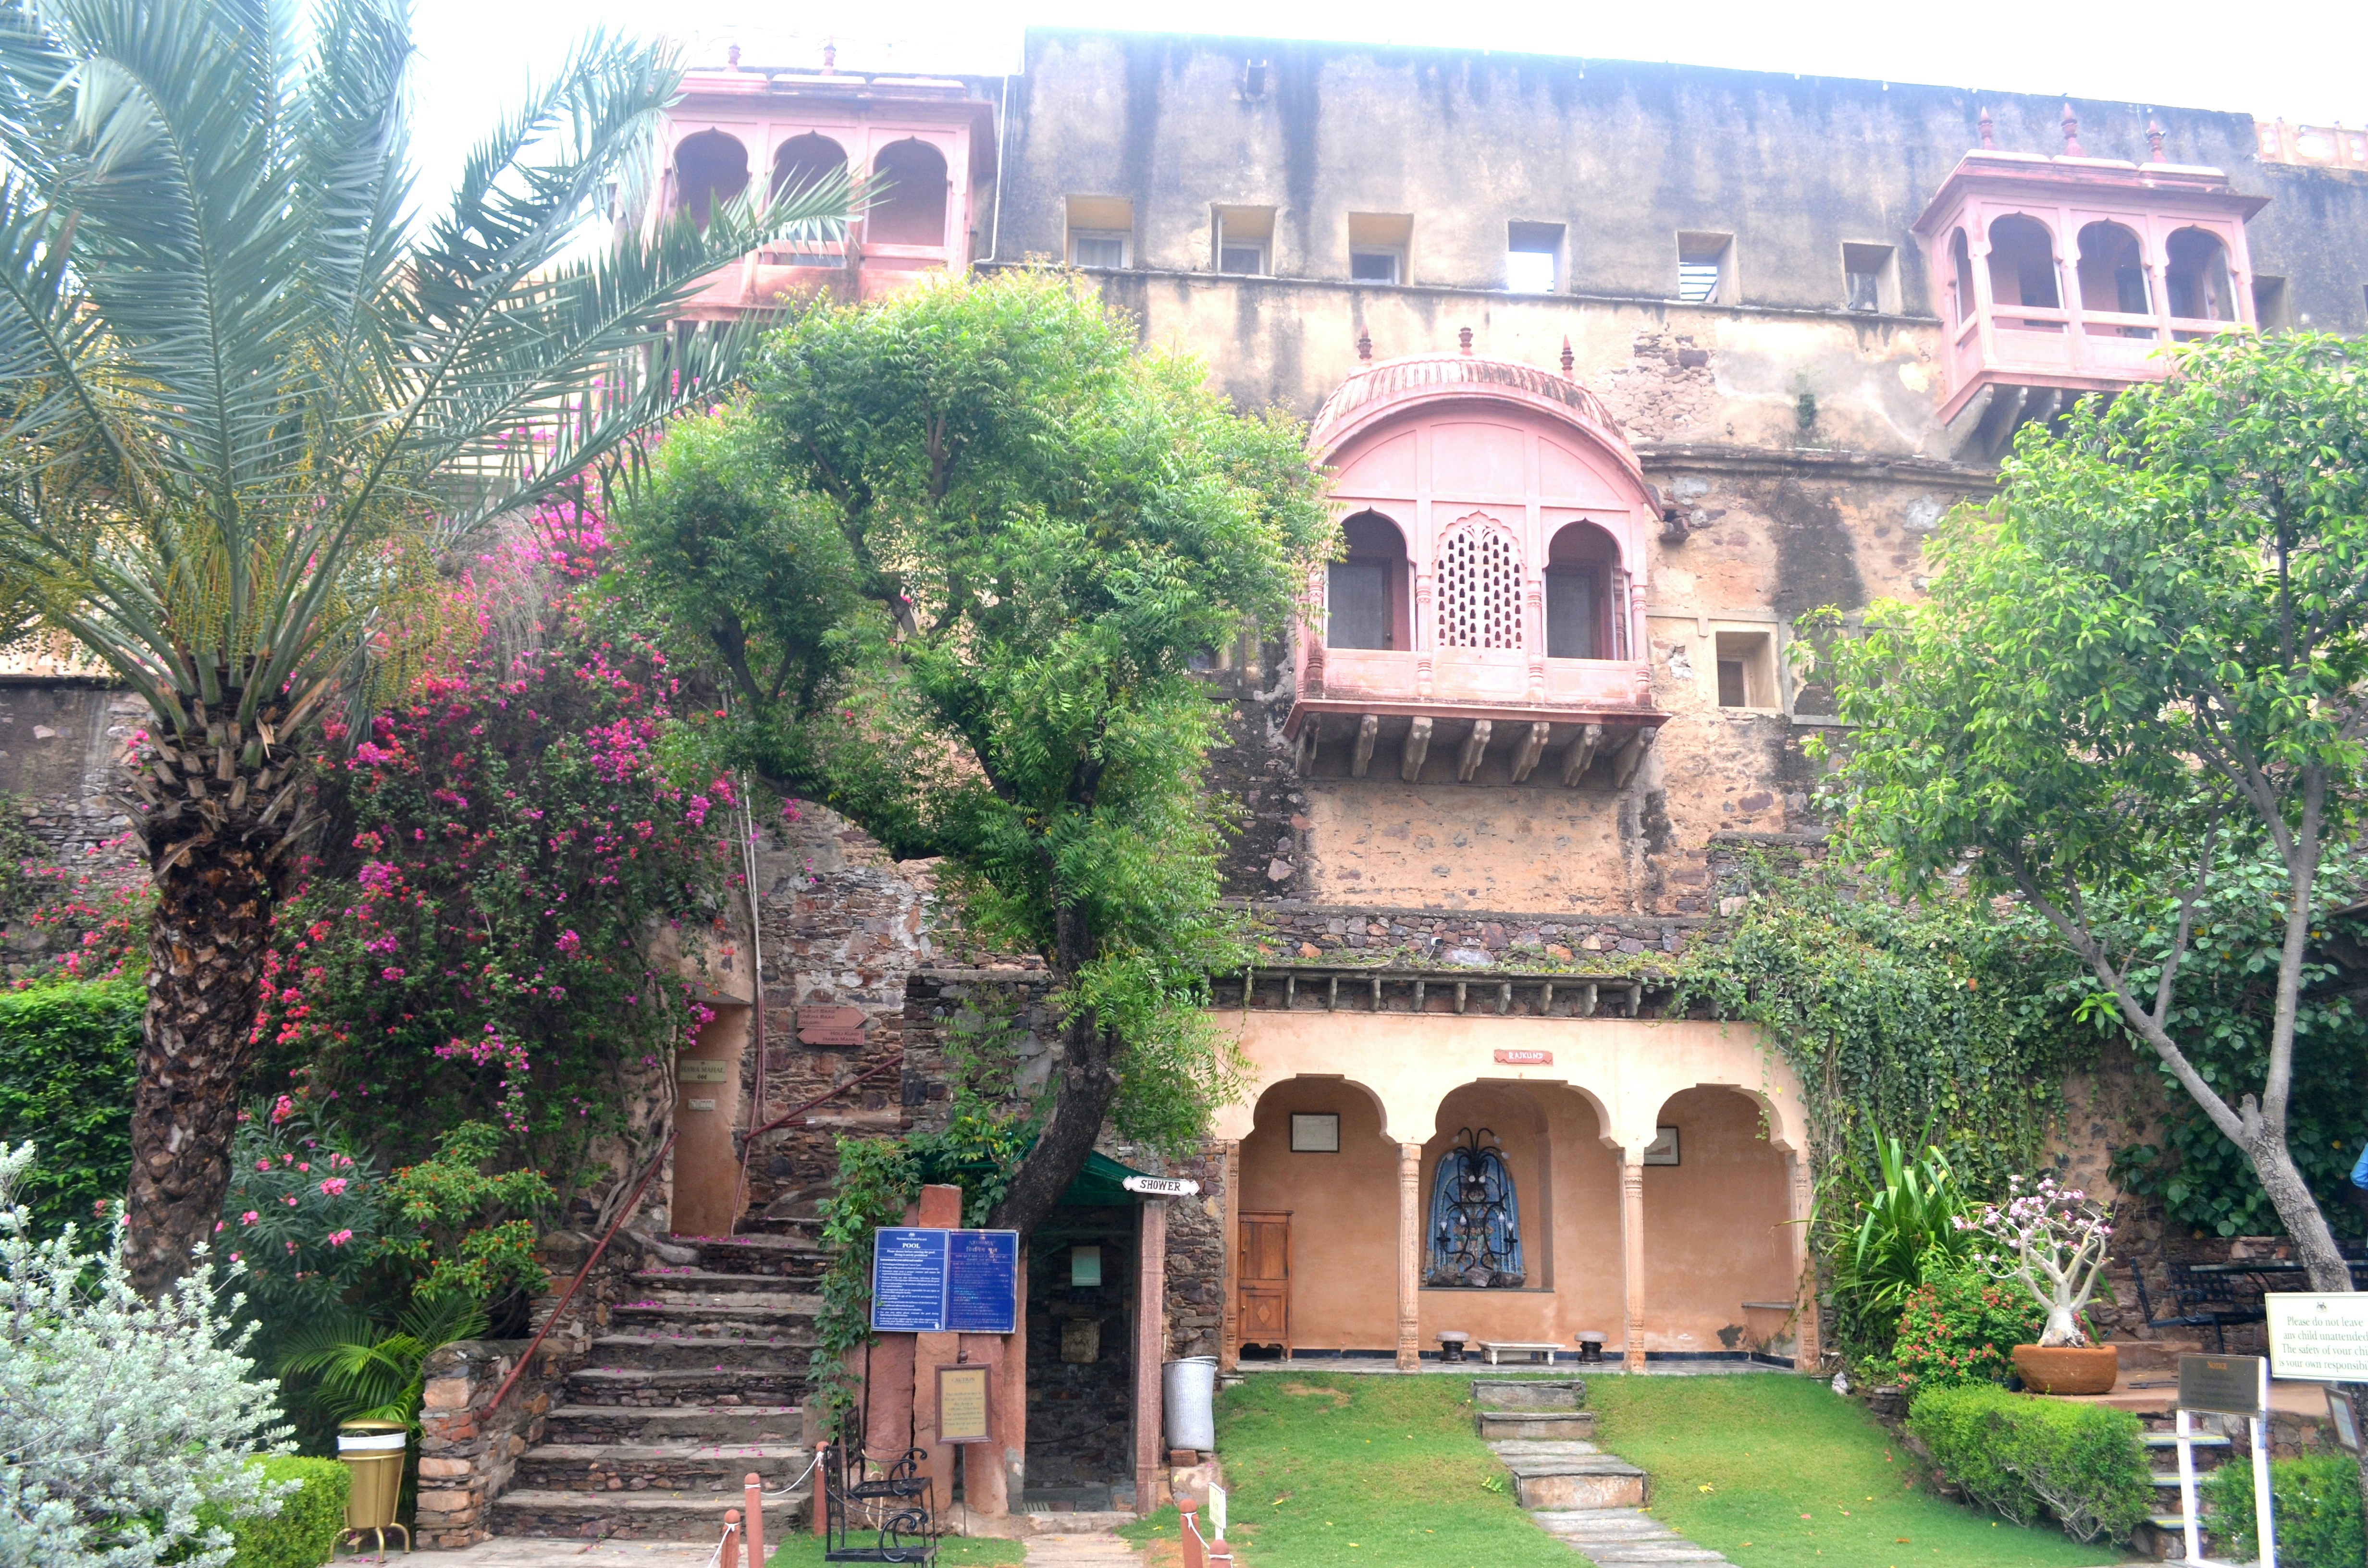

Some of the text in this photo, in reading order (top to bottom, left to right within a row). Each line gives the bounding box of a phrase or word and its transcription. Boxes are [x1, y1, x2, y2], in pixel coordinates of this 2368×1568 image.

[1140, 1179, 1181, 1191] SHOWER
[2287, 1316, 2310, 1326] Please
[2312, 1317, 2323, 1326] do
[2342, 1317, 2363, 1327] leave
[2283, 1330, 2368, 1342] any child unattended
[2282, 1343, 2296, 1353] The
[2298, 1344, 2320, 1357] safety
[2322, 1345, 2331, 1355] of
[2332, 1348, 2352, 1358] your
[2279, 1358, 2284, 1367] is
[2286, 1360, 2303, 1370] your
[2324, 1360, 2368, 1372] responsibi
